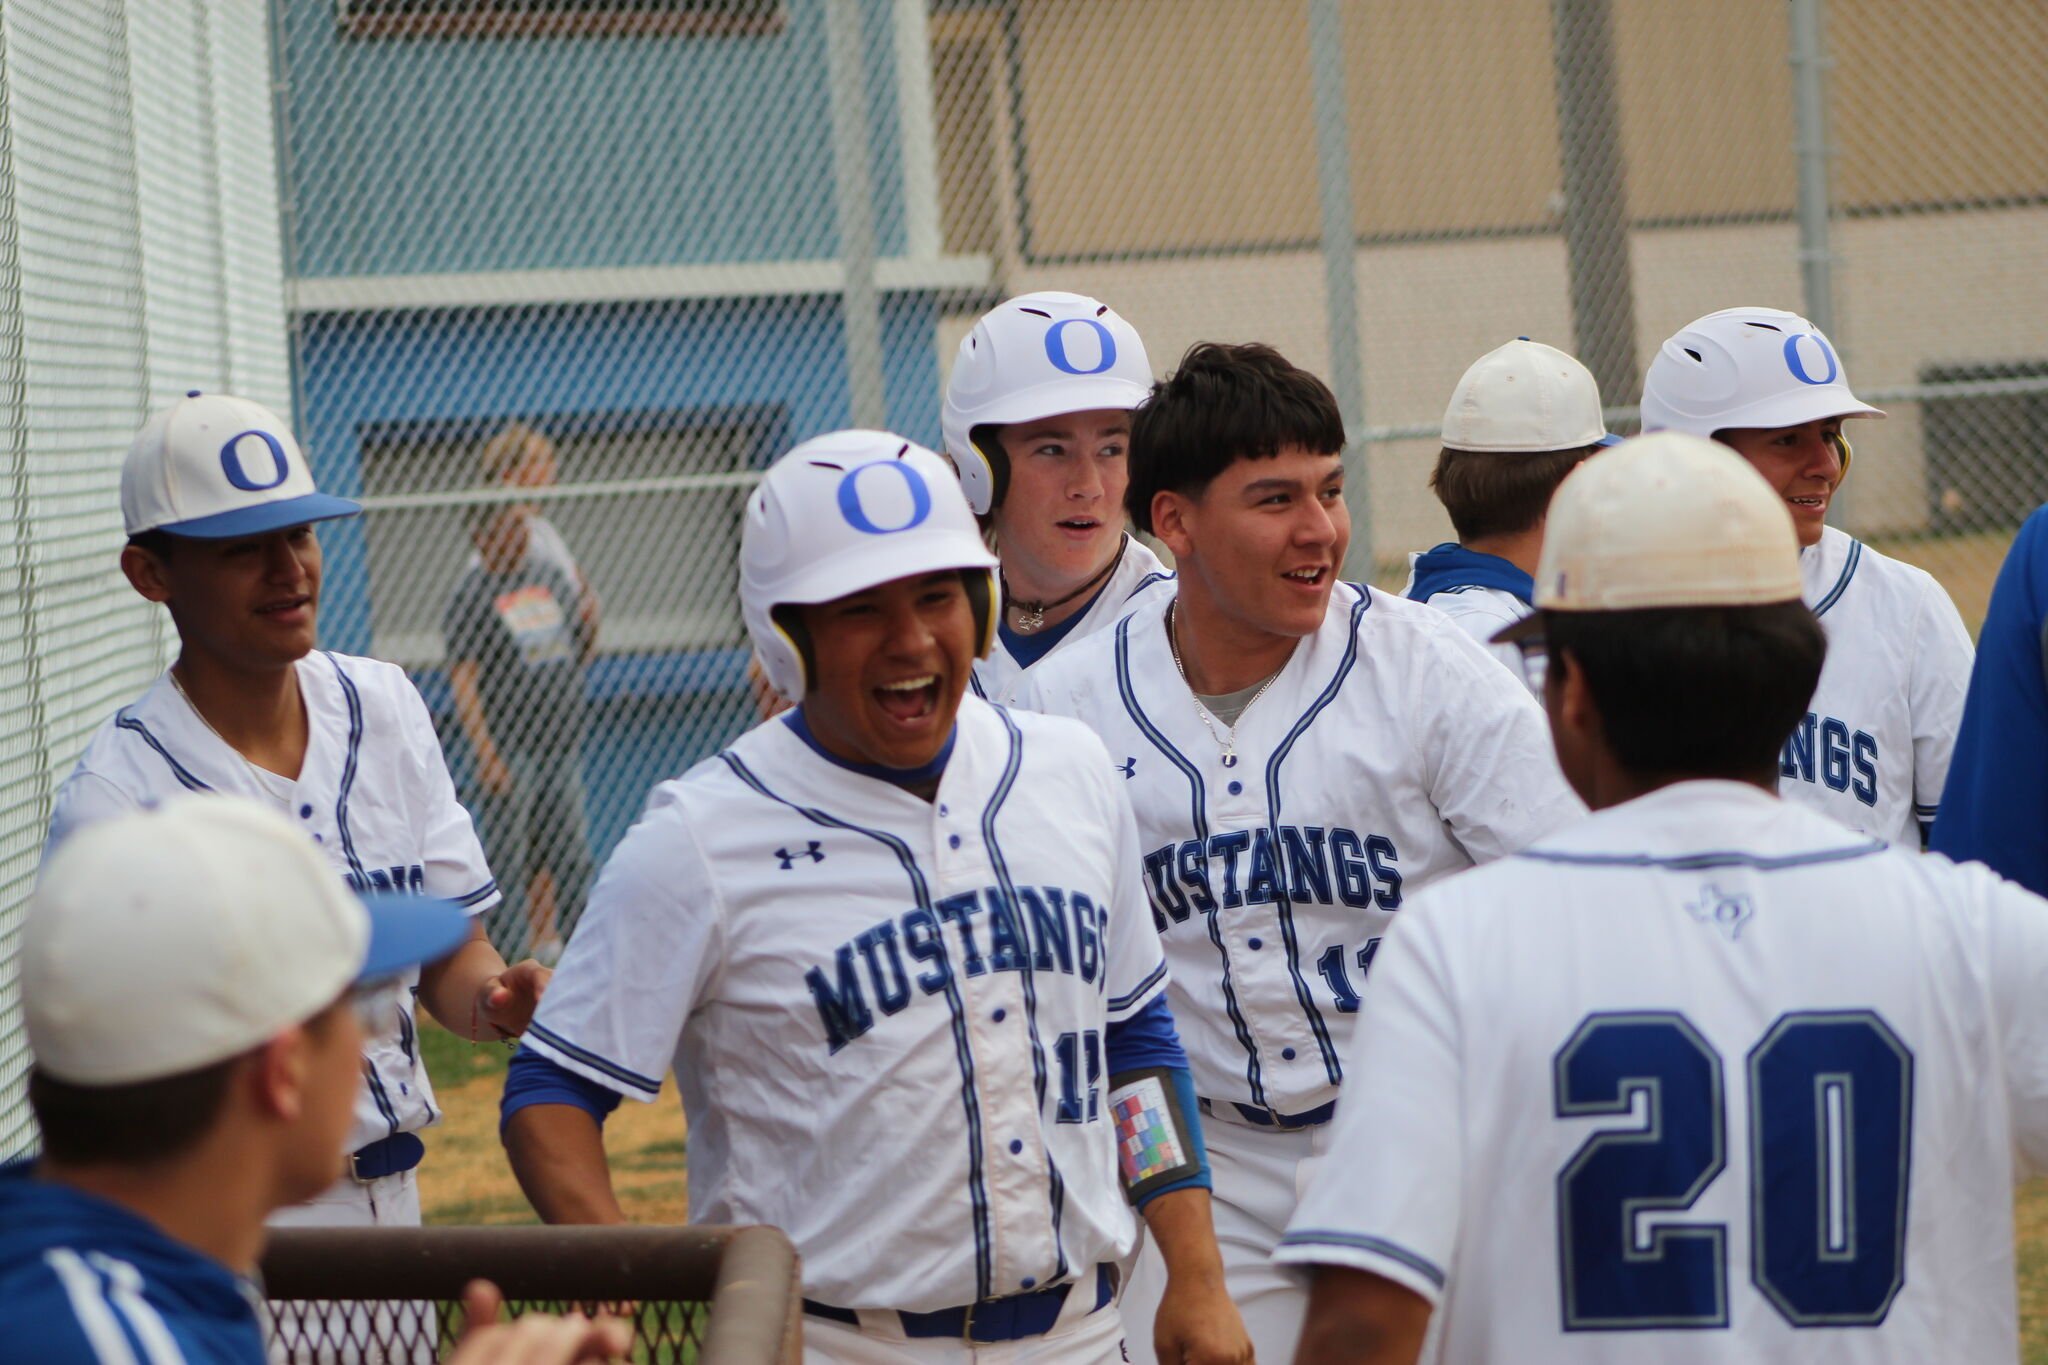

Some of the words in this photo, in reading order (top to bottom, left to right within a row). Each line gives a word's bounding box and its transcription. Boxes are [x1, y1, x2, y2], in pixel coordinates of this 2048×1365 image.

[1045, 319, 1116, 374] O
[1784, 334, 1836, 385] O
[220, 430, 288, 490] O
[838, 461, 931, 533] O
[1143, 826, 1402, 933] USTANGS
[1554, 1010, 1914, 1331] 20
